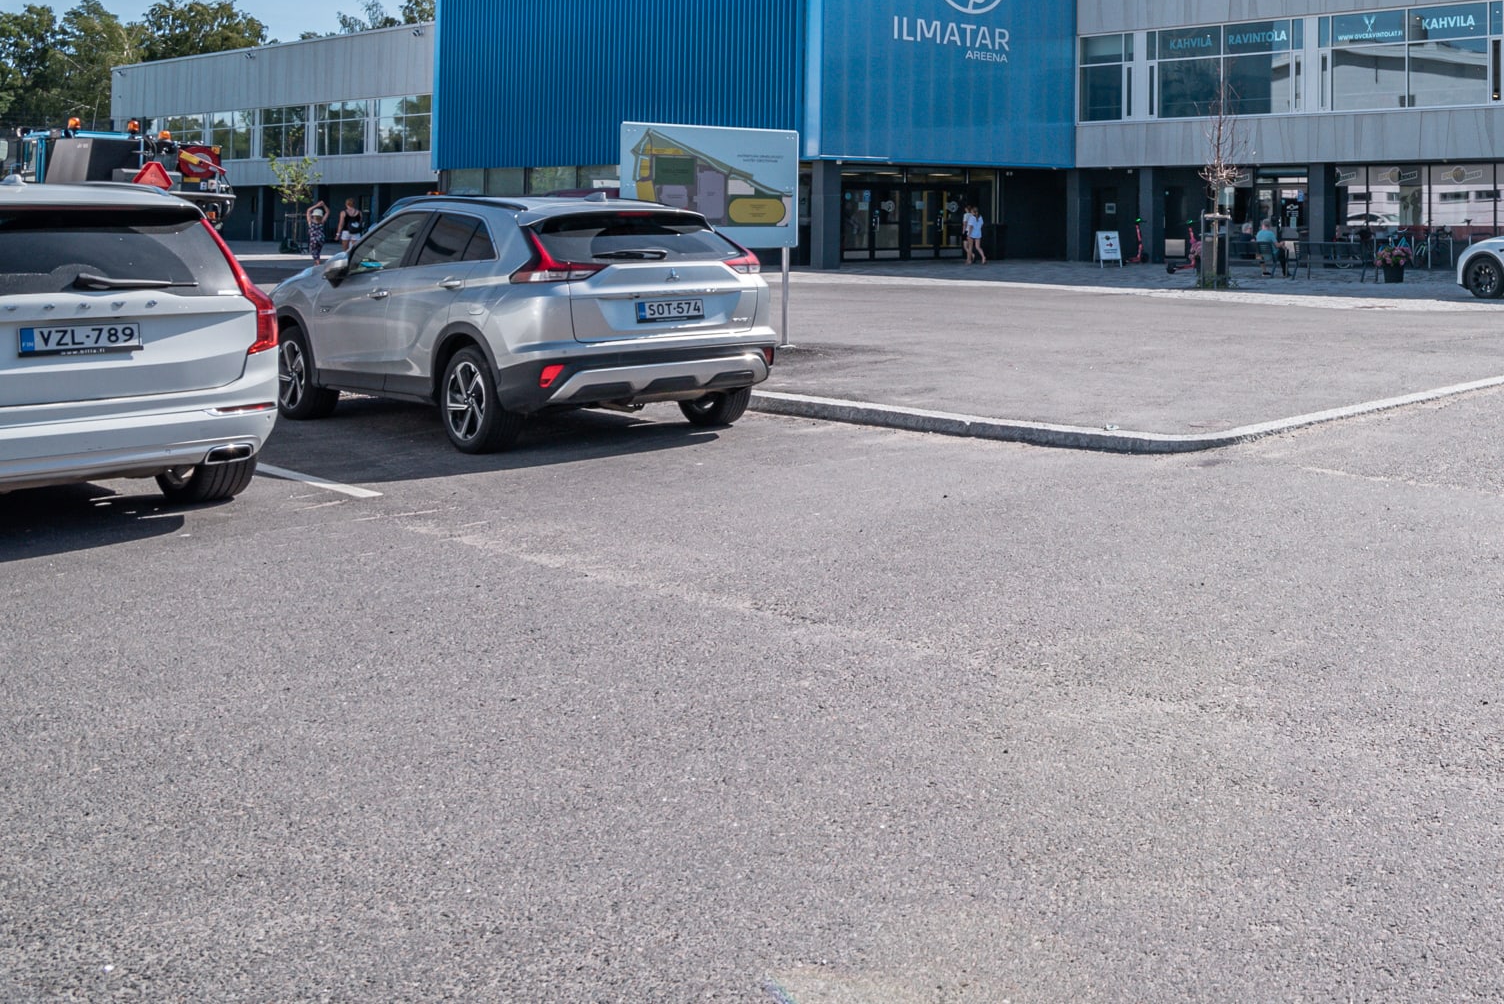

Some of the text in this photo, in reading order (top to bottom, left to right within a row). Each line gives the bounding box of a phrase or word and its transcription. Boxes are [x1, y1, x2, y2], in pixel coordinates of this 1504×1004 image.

[1421, 14, 1476, 30] KAHVILA
[893, 15, 1010, 51] ILMATAR
[1169, 29, 1288, 50] KAHVILA RAVINTOLA
[965, 50, 1008, 63] AREENA
[648, 301, 702, 316] SOT-574
[39, 326, 135, 347] VZL-789
